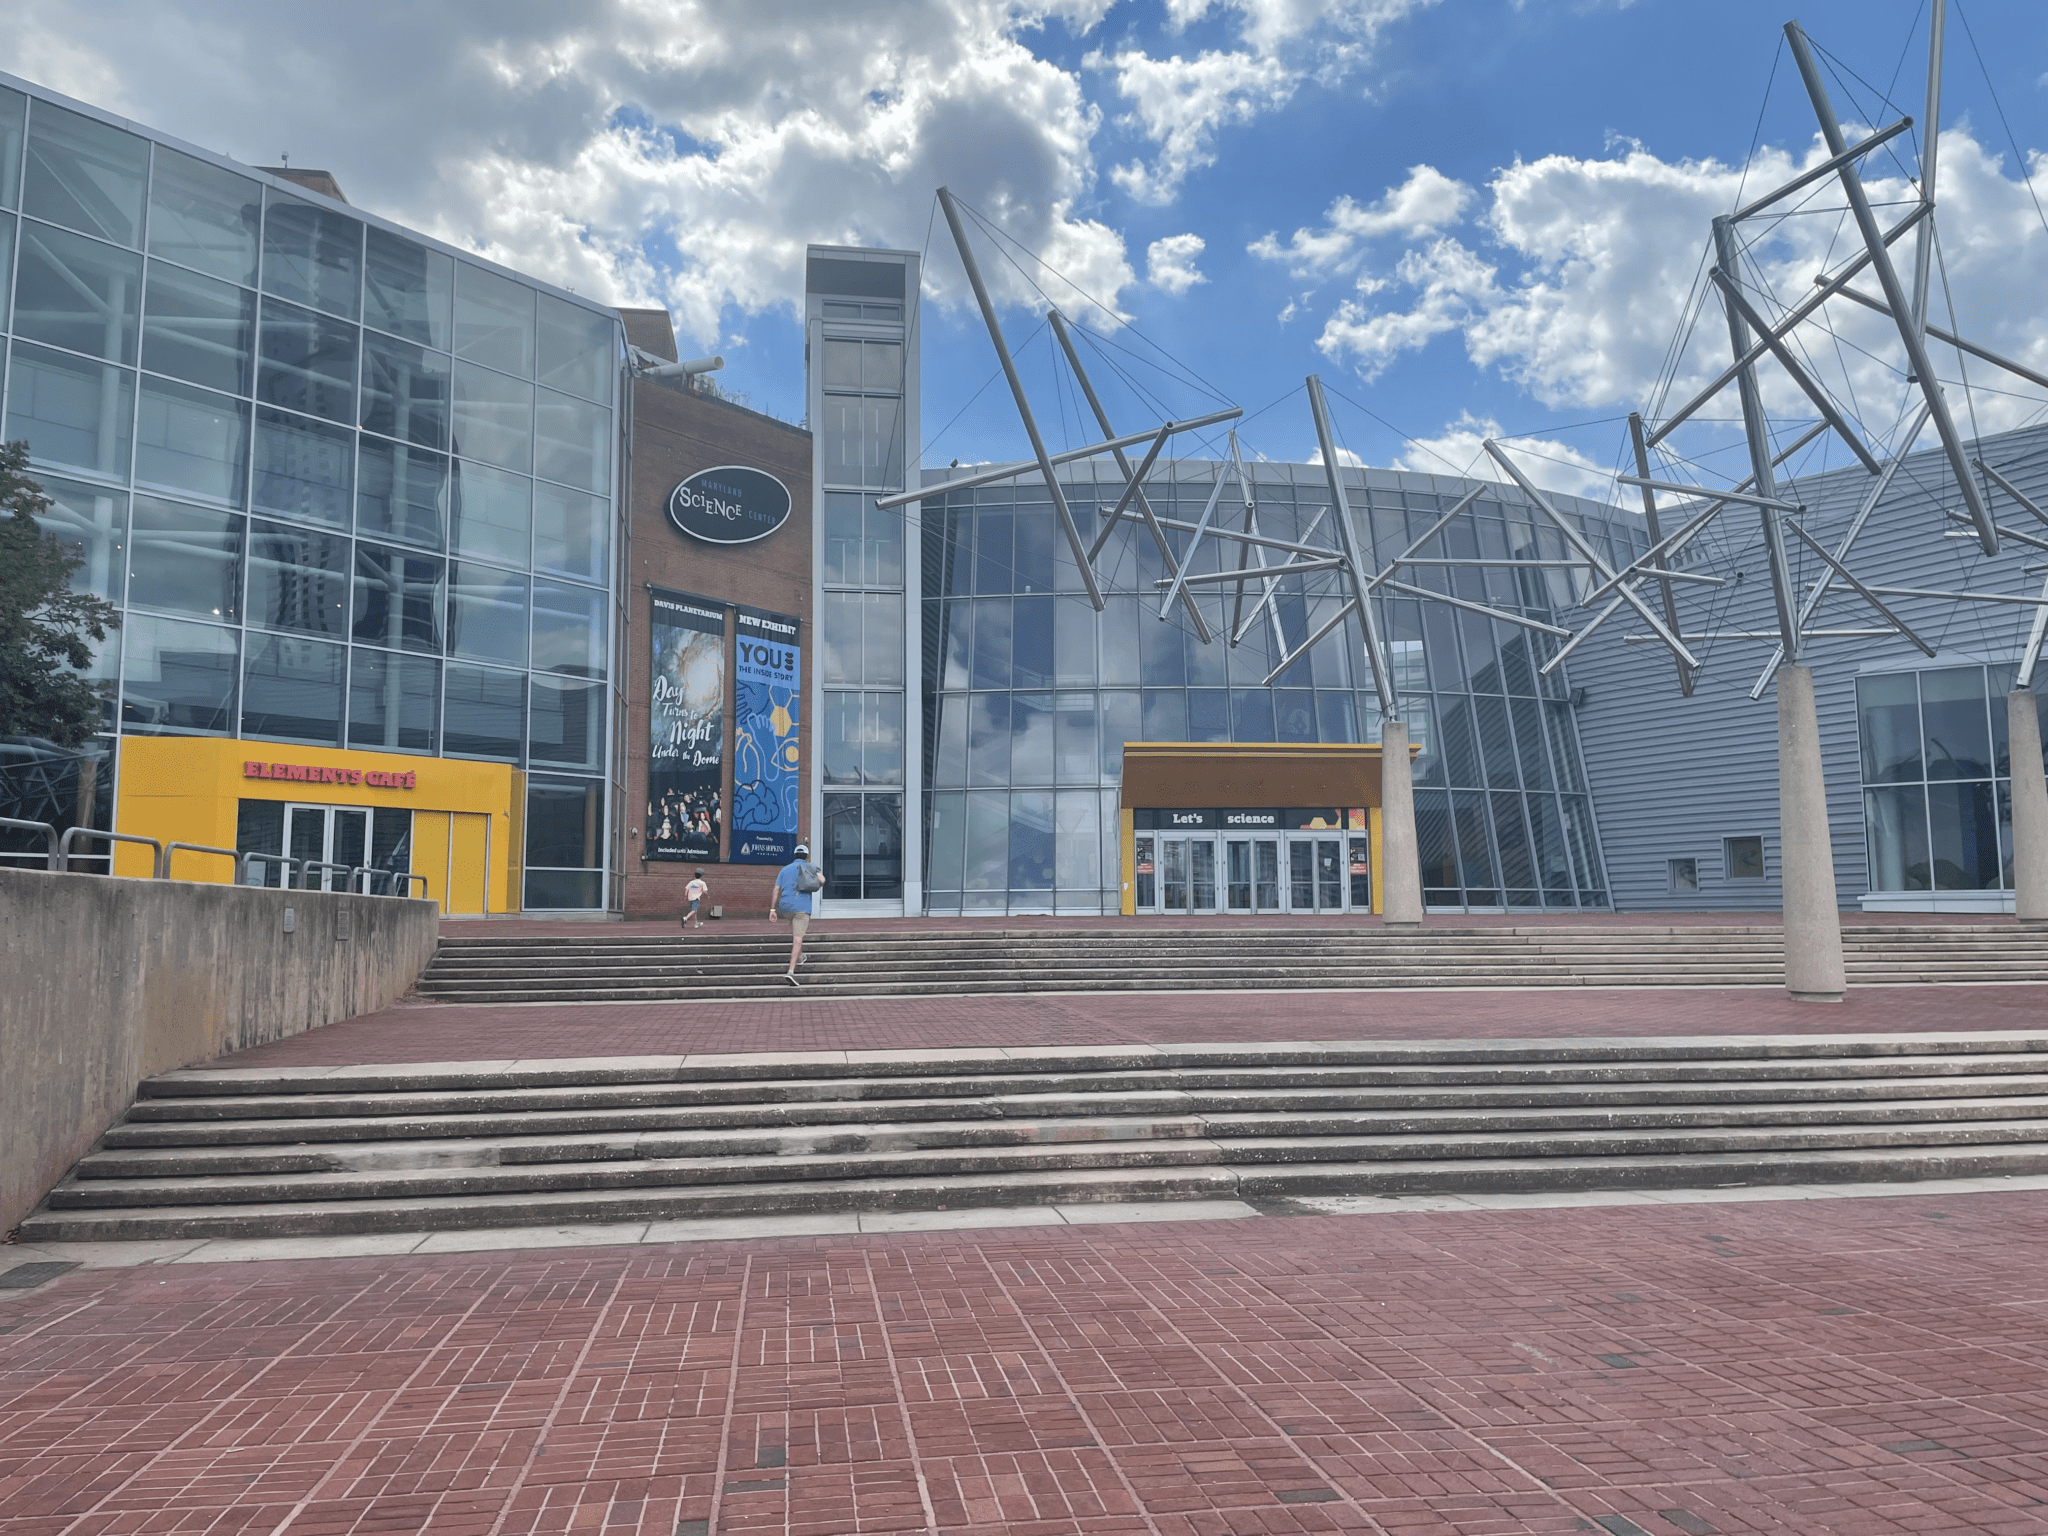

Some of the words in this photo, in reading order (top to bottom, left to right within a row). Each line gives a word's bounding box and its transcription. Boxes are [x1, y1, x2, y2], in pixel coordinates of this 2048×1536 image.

[701, 479, 742, 498] MARYLAND
[748, 510, 776, 525] CENTER
[654, 599, 675, 611] DAVIS
[675, 603, 723, 621] PLANETARIUM
[739, 614, 761, 627] NEW
[761, 619, 796, 635] EXHIBIT
[739, 665, 752, 674] THE
[753, 667, 772, 678] INSIDE
[774, 672, 793, 682] STORY
[653, 675, 684, 706] Day
[662, 702, 688, 717] Turns
[690, 709, 698, 720] to
[669, 719, 715, 750] Night
[652, 742, 679, 759] Under
[682, 750, 691, 760] the
[692, 750, 720, 767] Dome
[243, 761, 364, 786] ELEMENTS
[365, 769, 417, 790] CAFÉ
[1173, 813, 1203, 825] Let's
[1227, 813, 1275, 825] science
[766, 844, 784, 853] HOPKINS
